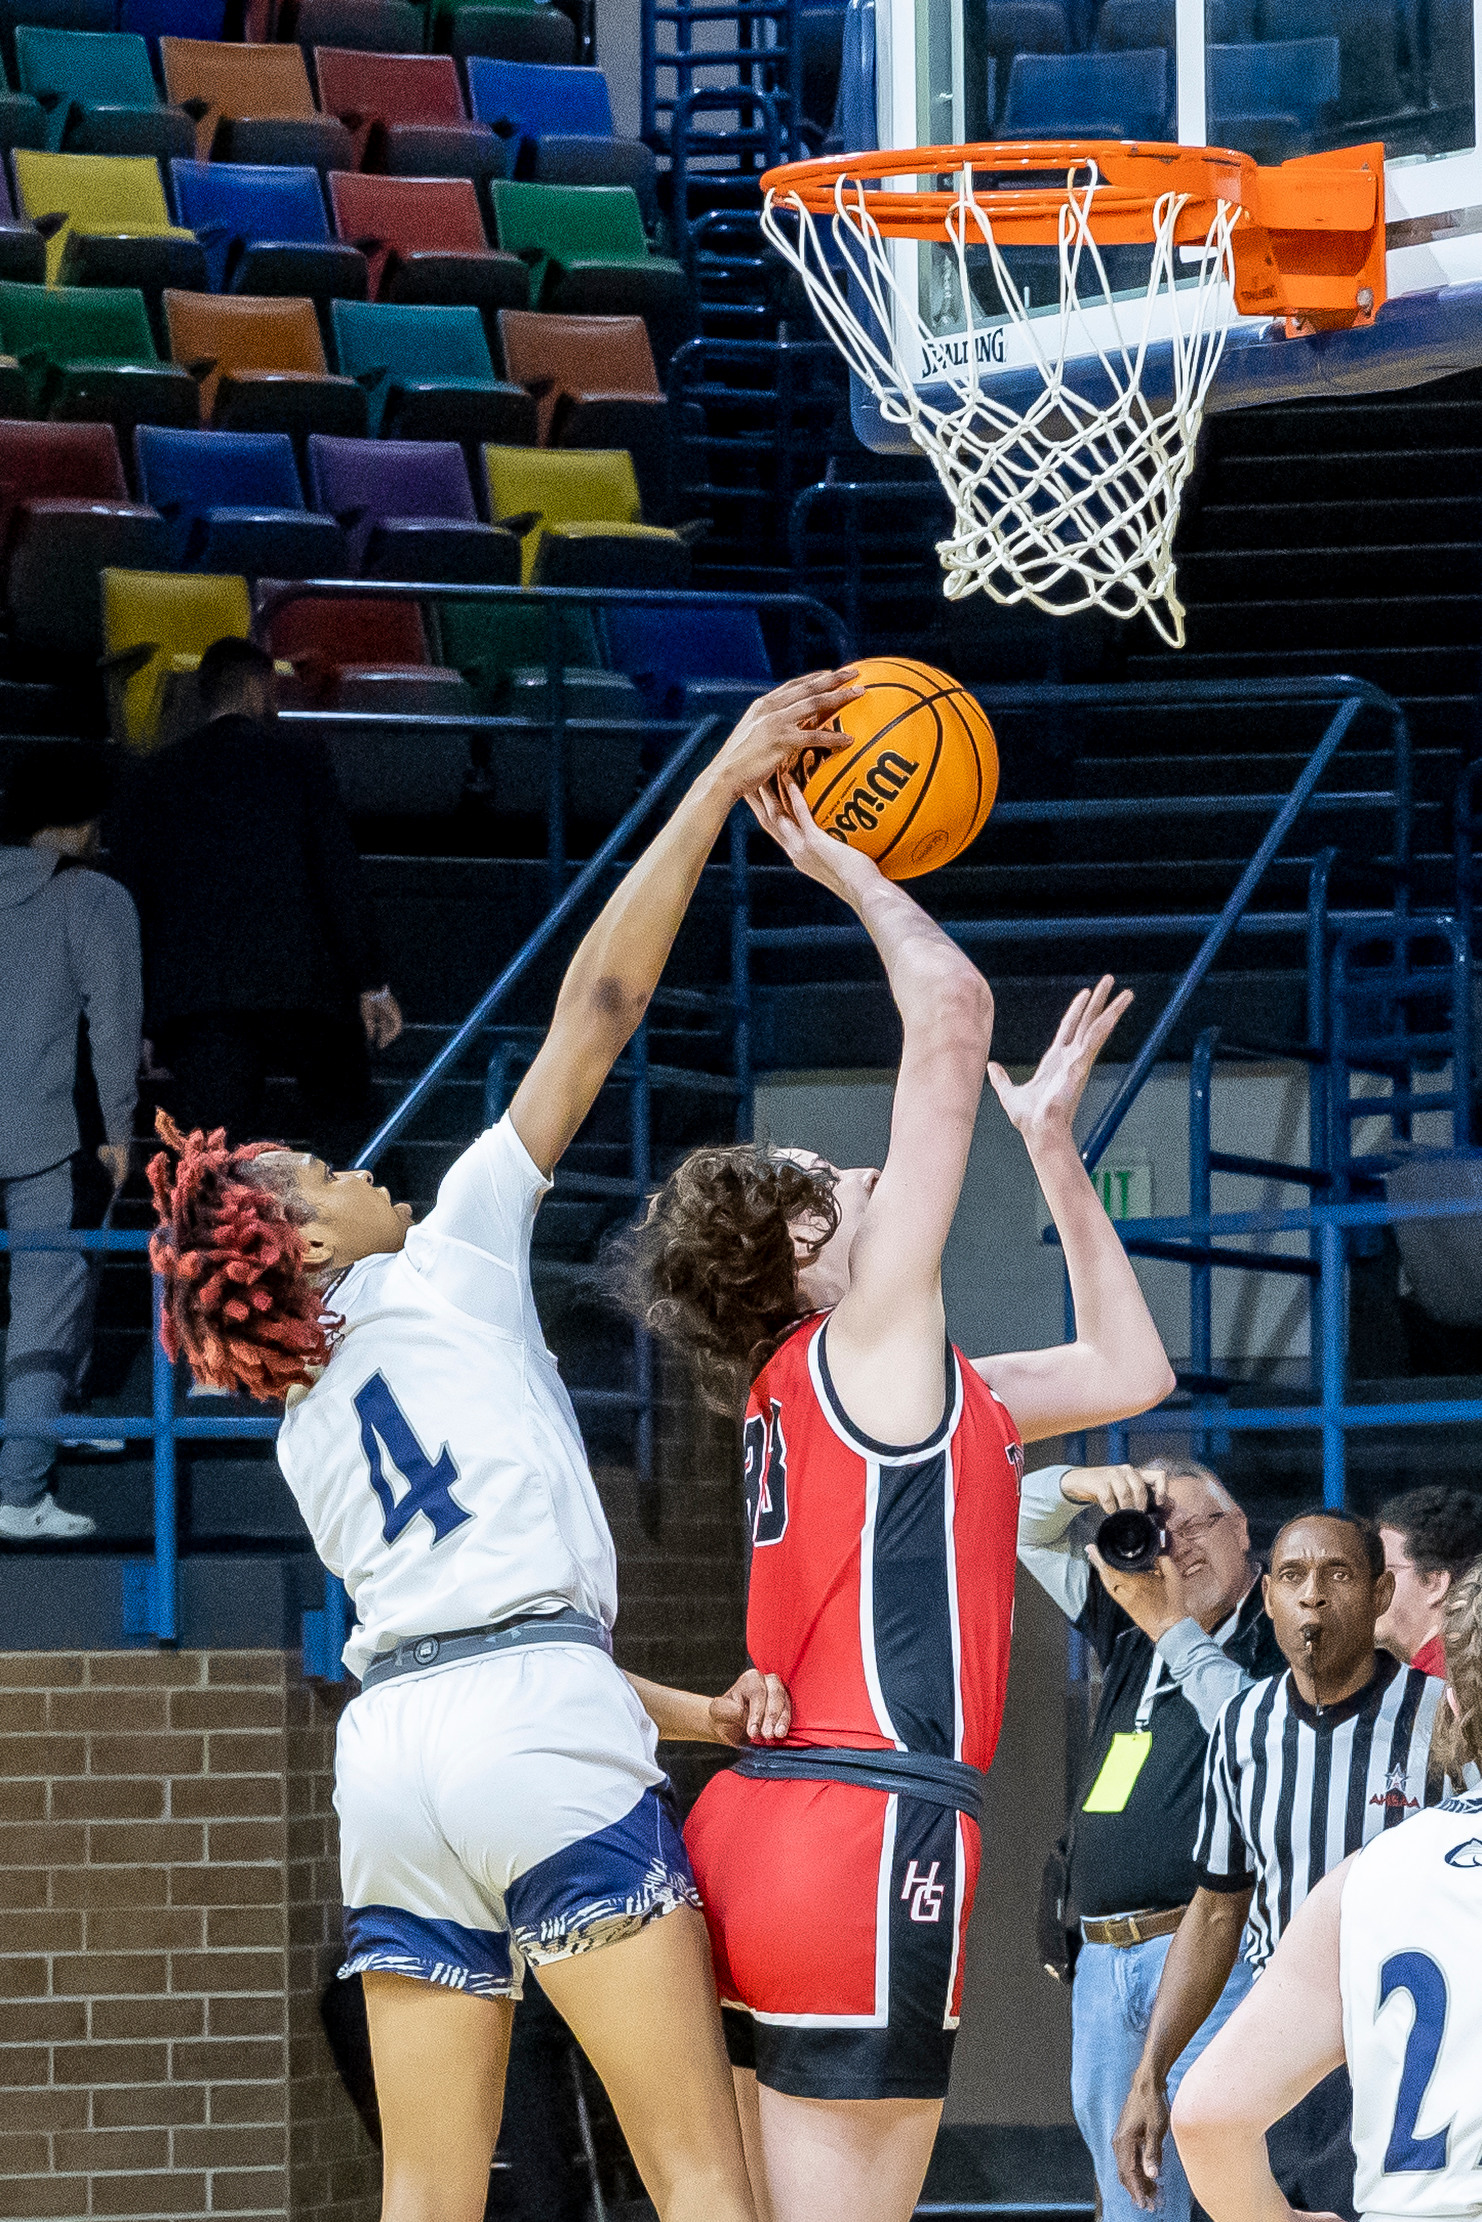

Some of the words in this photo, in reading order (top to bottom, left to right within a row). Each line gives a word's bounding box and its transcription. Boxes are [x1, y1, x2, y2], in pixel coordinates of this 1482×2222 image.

[351, 1367, 477, 1550] 4
[901, 1860, 944, 1922] HG
[1374, 1947, 1482, 2178] 2
